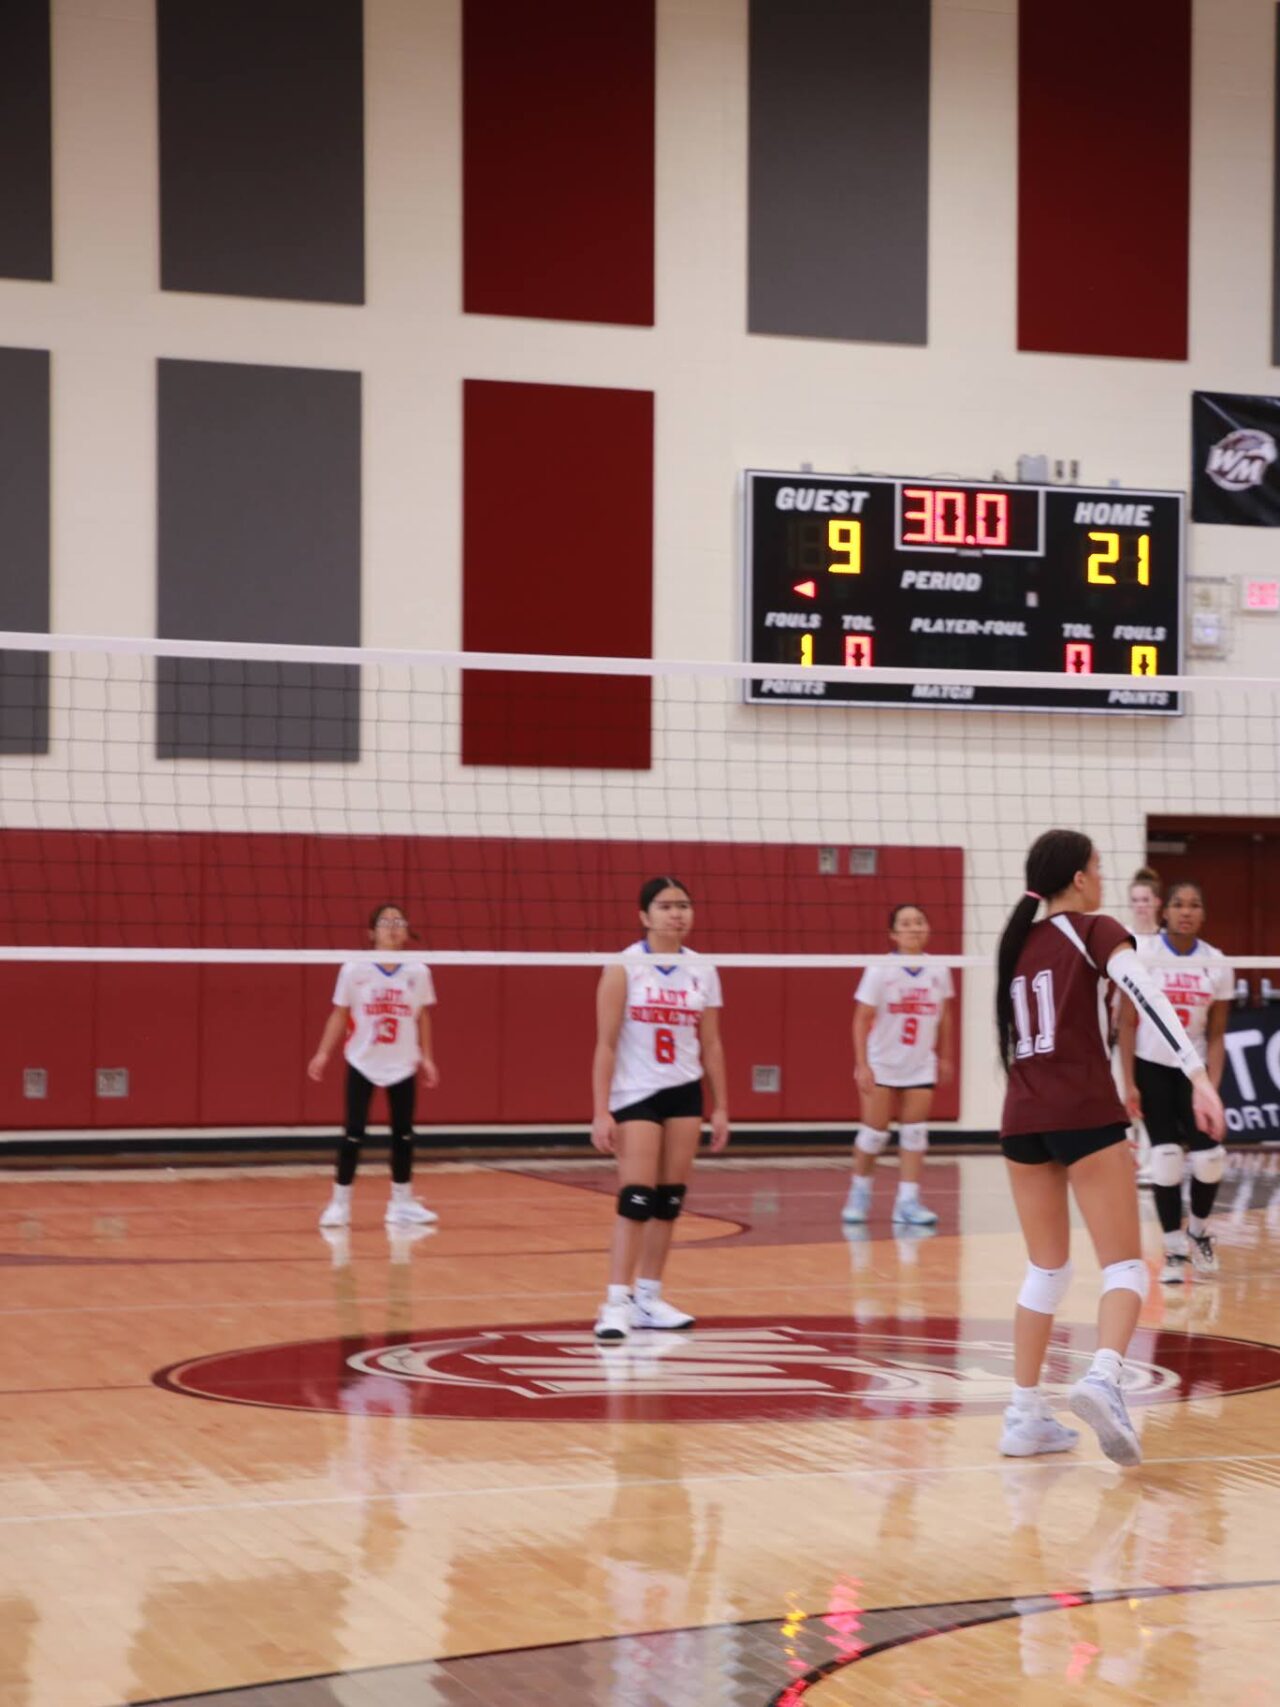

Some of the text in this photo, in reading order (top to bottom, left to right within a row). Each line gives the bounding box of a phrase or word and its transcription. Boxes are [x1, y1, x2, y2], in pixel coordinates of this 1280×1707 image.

[1206, 444, 1267, 486] WM
[775, 486, 870, 514] GUEST
[903, 489, 1007, 546] 30.0
[1073, 501, 1154, 527] HOME
[828, 519, 861, 574] 9
[1087, 531, 1149, 586] 21
[900, 569, 982, 592] PERIOD
[764, 612, 822, 629] FOULS
[841, 614, 875, 631] TOL
[910, 617, 1028, 636] PLAYER-FOUL
[1061, 622, 1095, 639] TOL
[1112, 624, 1167, 641] FOULS
[845, 635, 872, 668] 0
[1065, 643, 1092, 675] 0
[1131, 645, 1157, 677] 0
[760, 679, 826, 695] POINTS
[912, 684, 975, 700] MATCH
[1107, 689, 1169, 705] POINTS
[645, 986, 688, 1007] LADY
[1010, 968, 1056, 1059] 11
